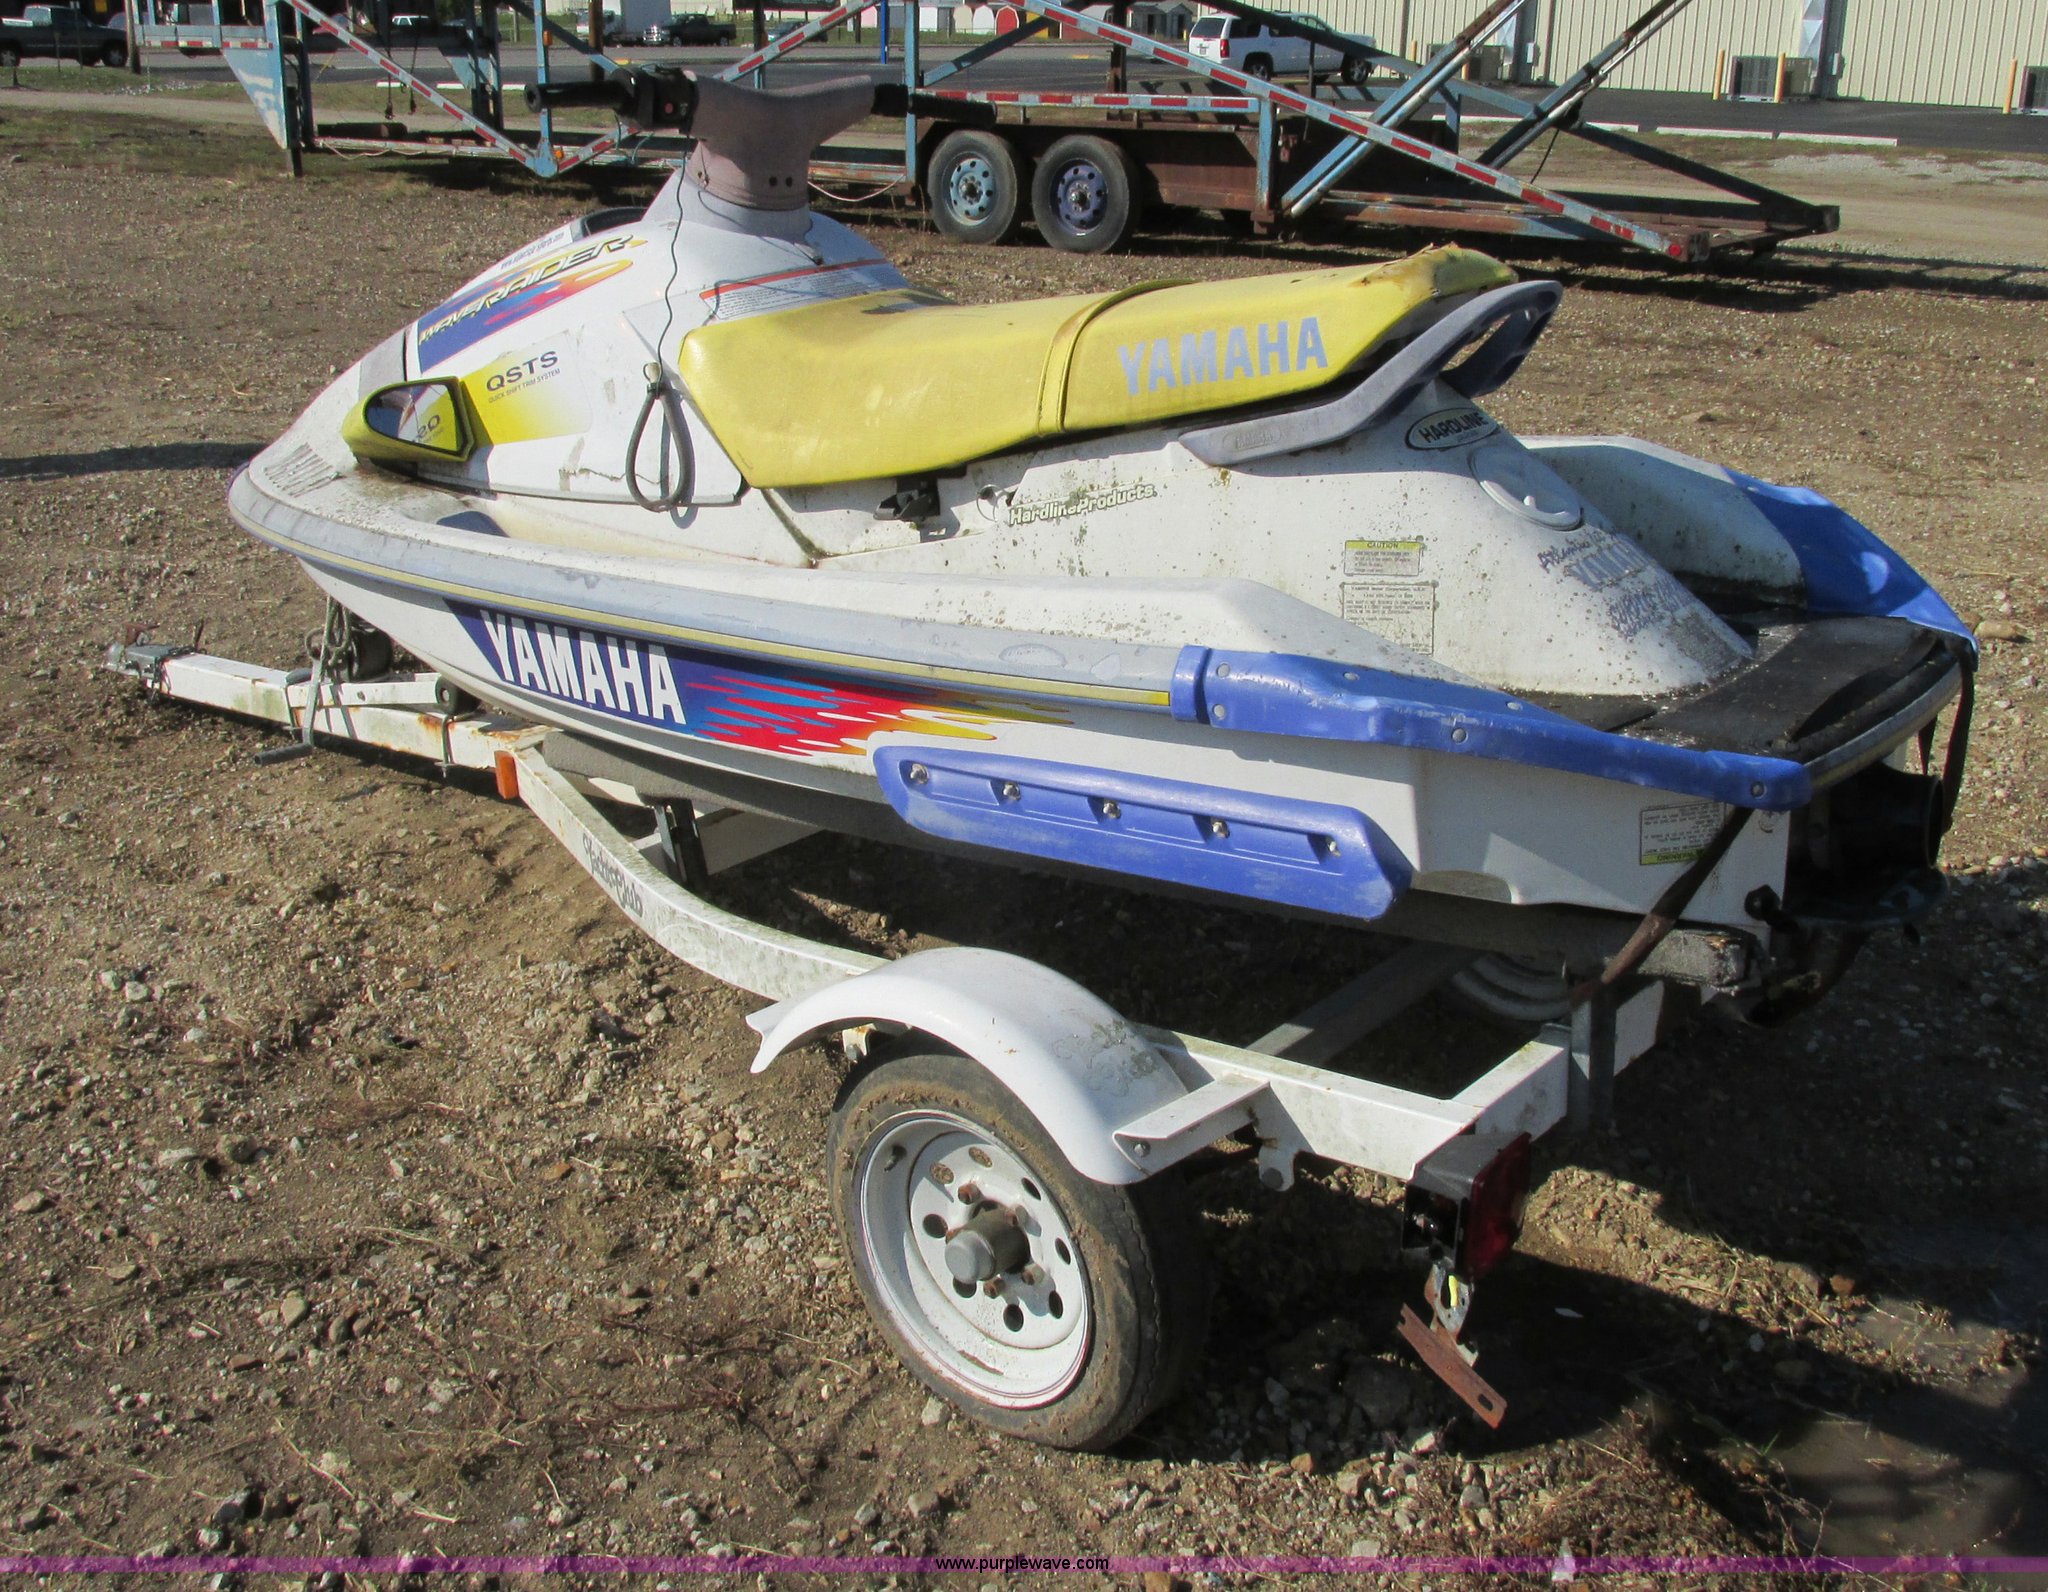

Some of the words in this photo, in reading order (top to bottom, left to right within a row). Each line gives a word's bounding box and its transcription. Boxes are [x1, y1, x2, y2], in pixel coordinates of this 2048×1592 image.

[487, 350, 559, 393] QSTS
[536, 367, 561, 384] SYSTEM
[1117, 316, 1329, 397] YAMAHA
[1418, 412, 1489, 443] HARDLINE
[480, 608, 687, 725] YAMAHA
